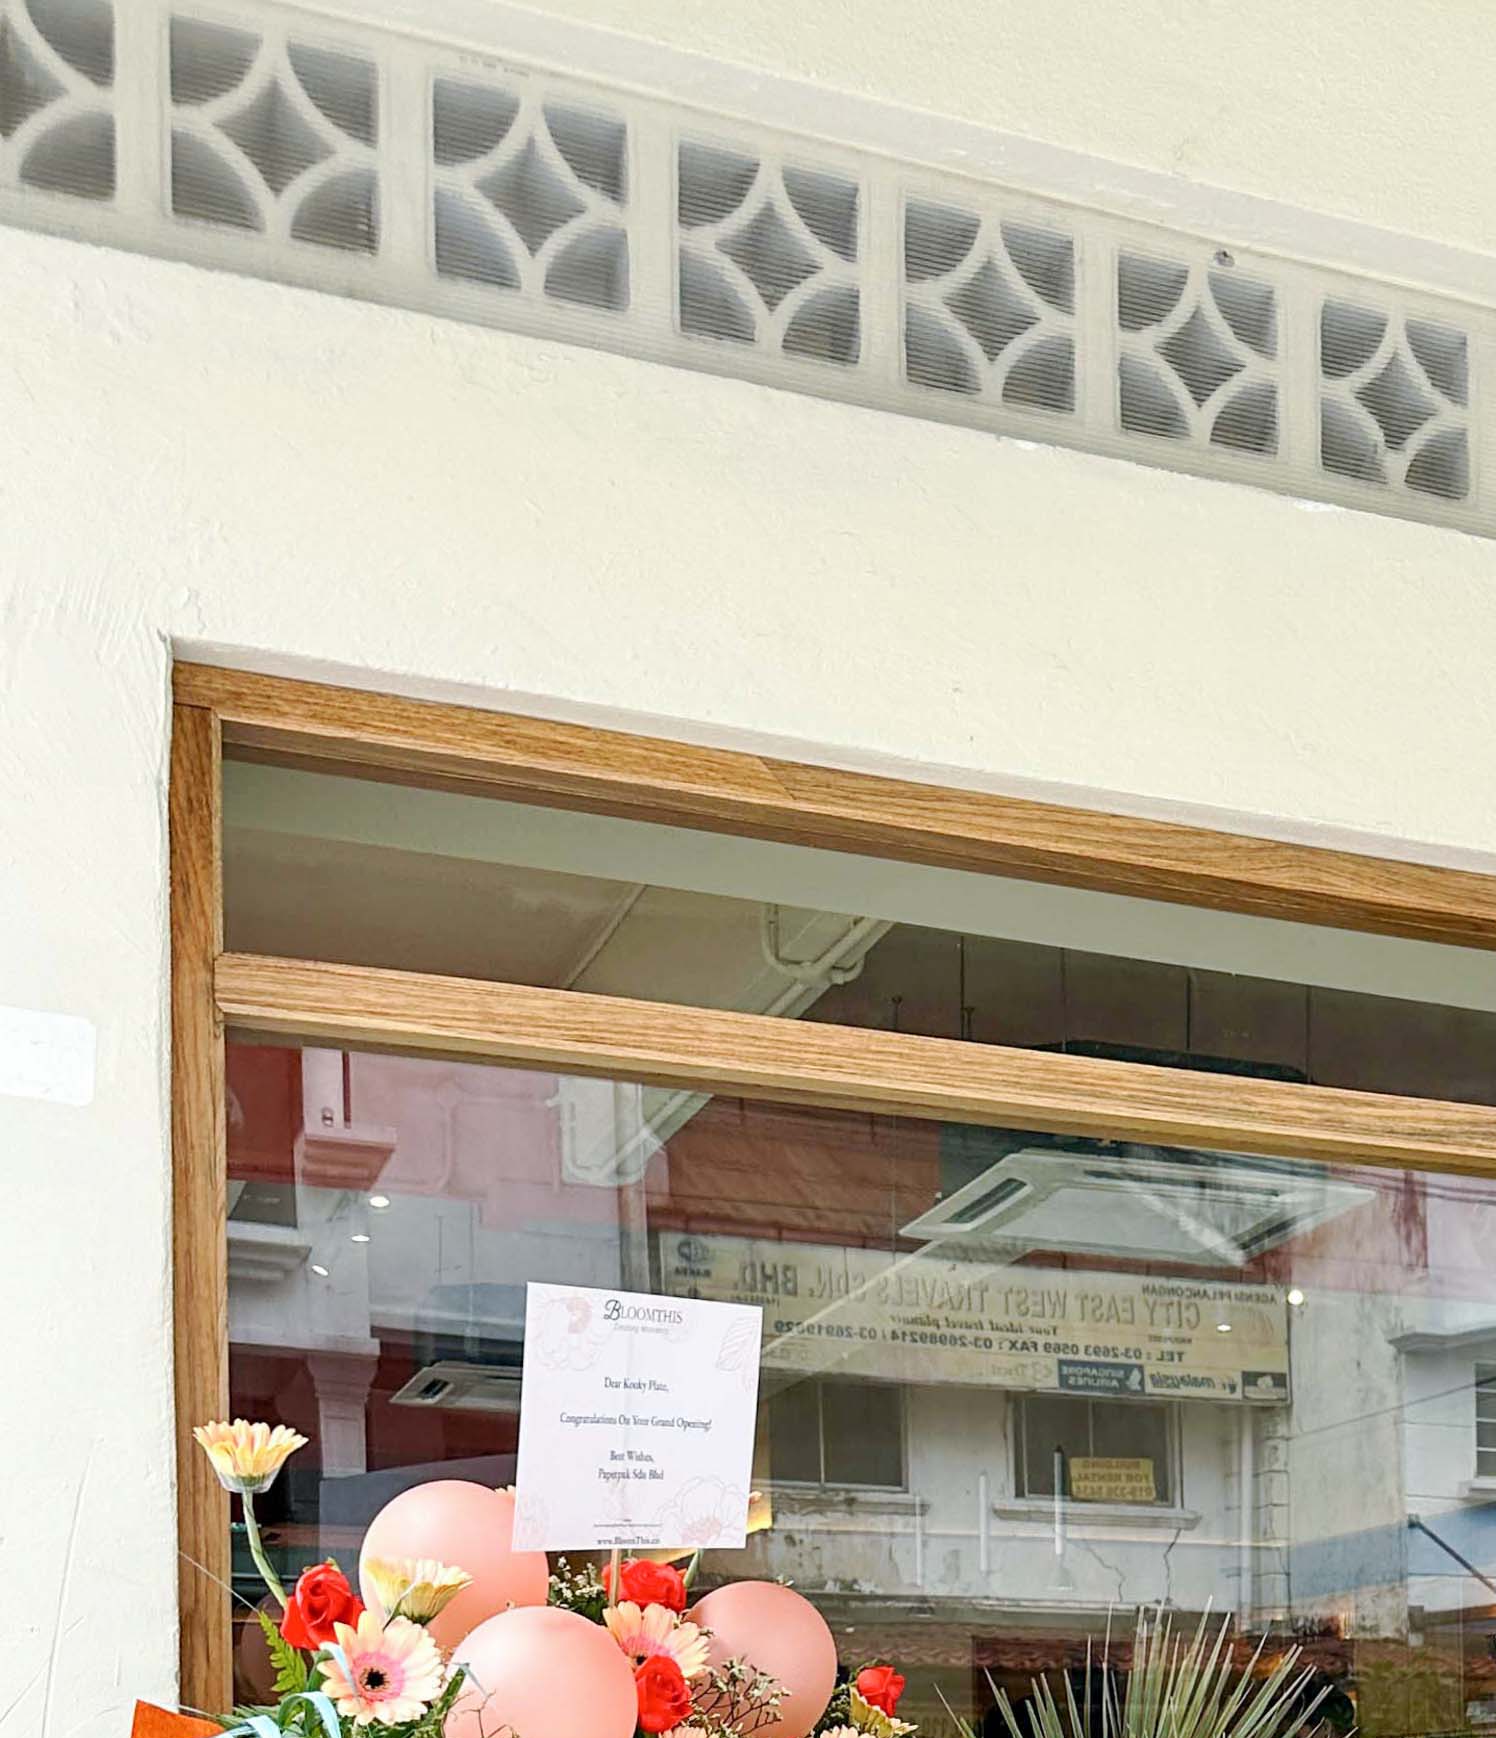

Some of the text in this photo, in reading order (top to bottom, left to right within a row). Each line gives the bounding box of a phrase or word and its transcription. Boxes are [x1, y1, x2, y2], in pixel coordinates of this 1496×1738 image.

[604, 1376, 621, 1389] Dear
[618, 1414, 631, 1426] On
[632, 1415, 649, 1426] Your
[651, 1416, 675, 1428] Grand
[610, 1450, 625, 1461] Best
